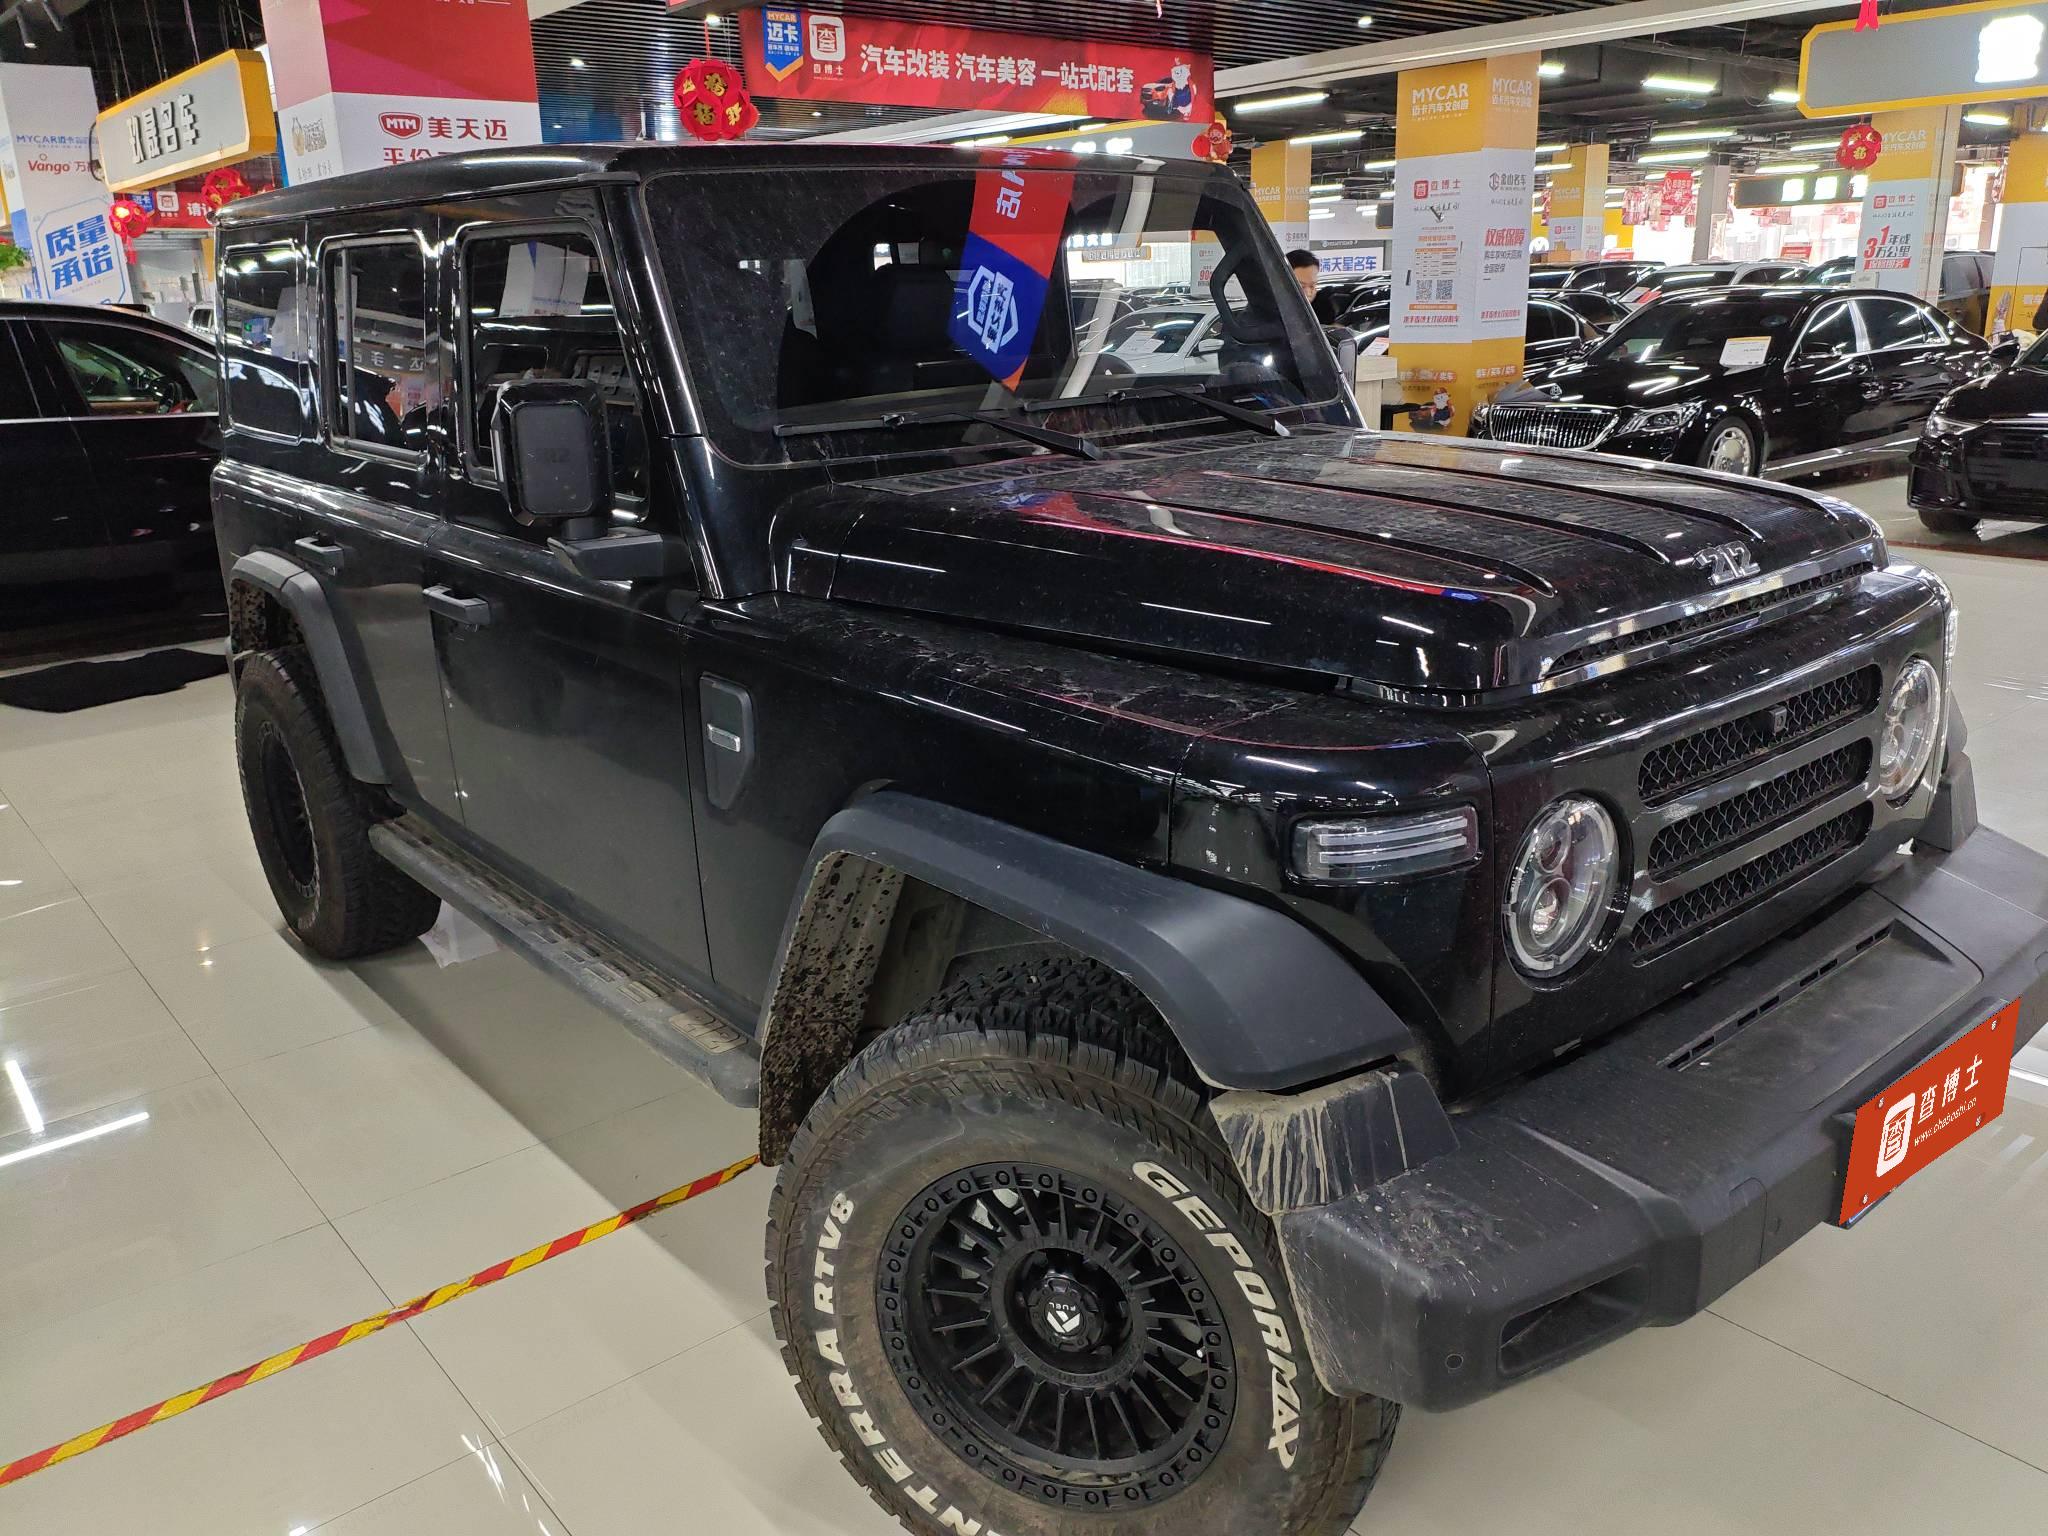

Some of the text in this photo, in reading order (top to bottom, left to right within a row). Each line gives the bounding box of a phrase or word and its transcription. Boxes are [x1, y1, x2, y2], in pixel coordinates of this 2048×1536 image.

[767, 12, 797, 22] MYCAR
[767, 21, 799, 43] 迈卡
[860, 44, 1134, 94] 汽车改装 汽车美容 一站式配套
[1412, 83, 1469, 103] MYCAR
[1492, 78, 1533, 95] MYCAR
[387, 117, 417, 130] MTM
[428, 116, 508, 141] 美天迈
[28, 160, 70, 174] Vango
[45, 214, 109, 260] 质量
[1485, 228, 1525, 247] 权威保障
[1864, 238, 1911, 259] 3万公里
[51, 244, 114, 291] 承诺
[1319, 255, 1377, 272] 满天星名车
[1049, 1301, 1076, 1311] FUEL
